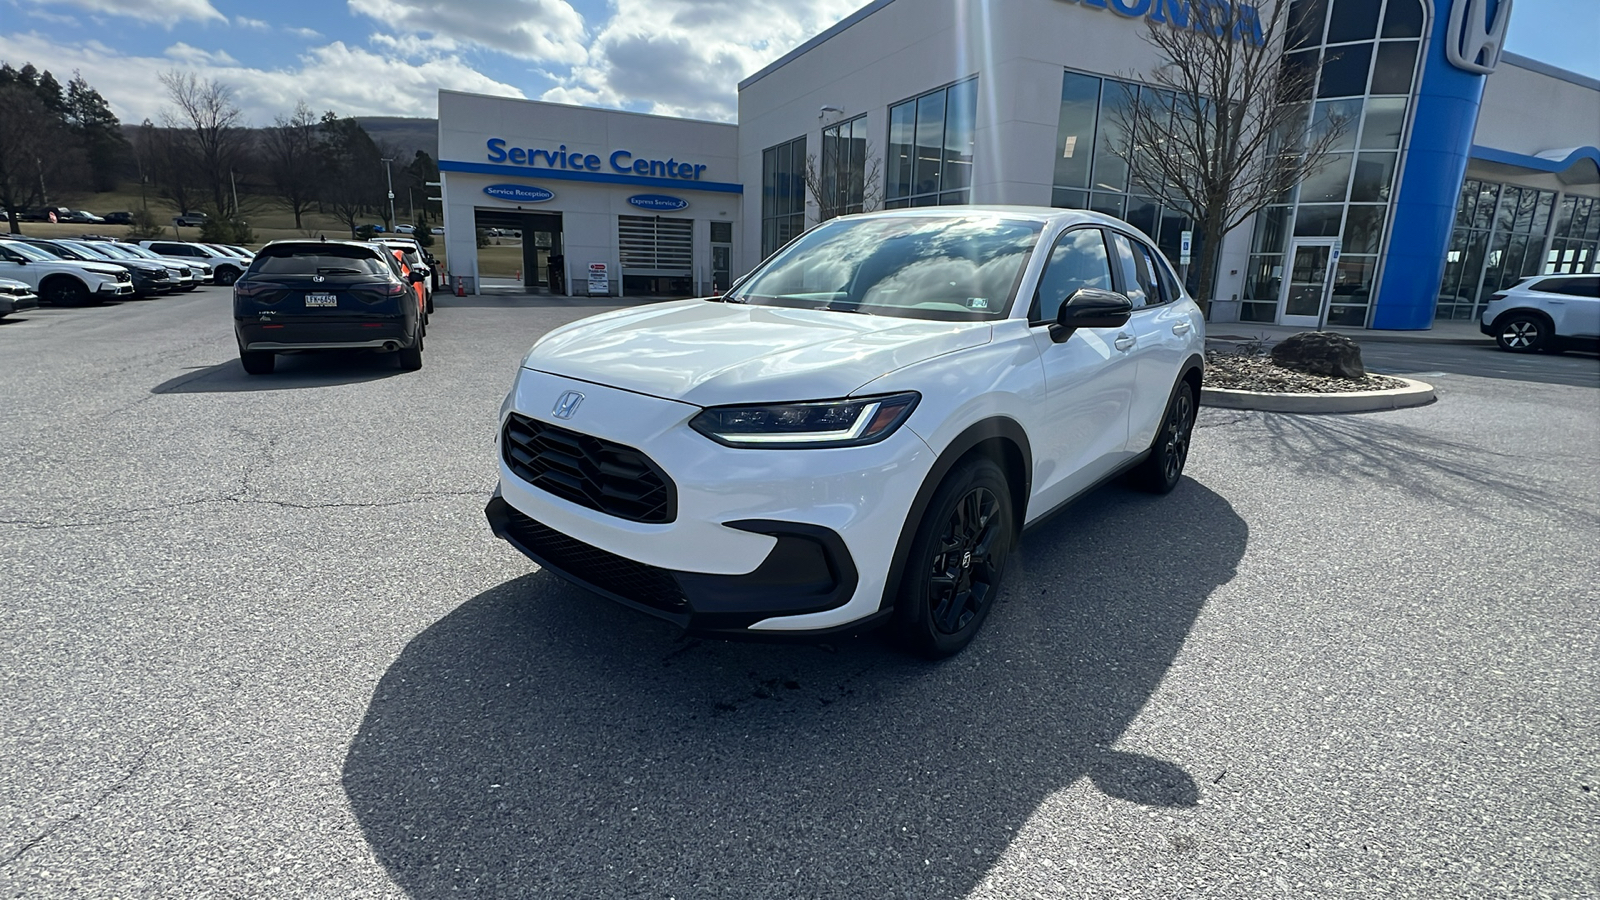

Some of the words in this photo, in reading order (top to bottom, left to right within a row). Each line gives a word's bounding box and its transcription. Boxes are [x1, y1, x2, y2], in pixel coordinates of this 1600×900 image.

[1050, 0, 1265, 48] NDA
[487, 138, 601, 171] Service
[609, 150, 707, 180] Center
[487, 187, 514, 195] Service
[515, 189, 550, 198] Reception
[630, 197, 654, 205] Express
